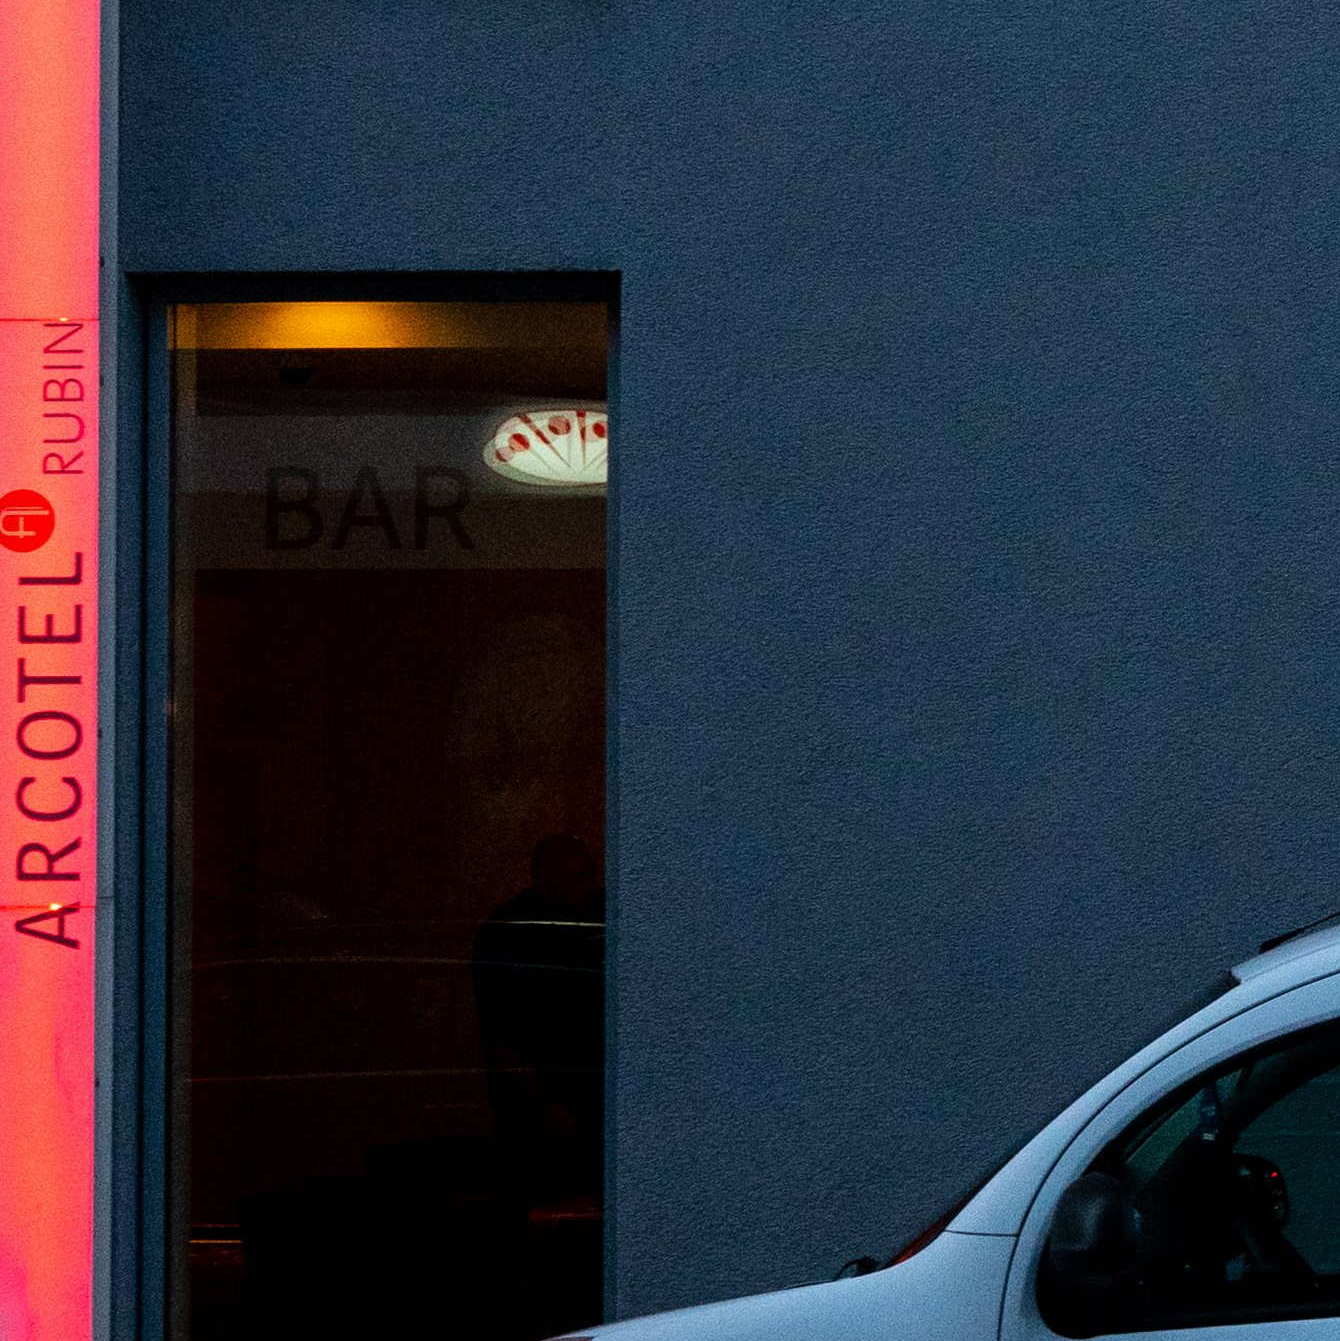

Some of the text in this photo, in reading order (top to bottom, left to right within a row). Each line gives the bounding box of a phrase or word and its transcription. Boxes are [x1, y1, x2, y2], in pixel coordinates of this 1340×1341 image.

[43, 321, 84, 475] RUBIN
[264, 465, 475, 550] BAR
[15, 551, 83, 950] ARCOTEL
